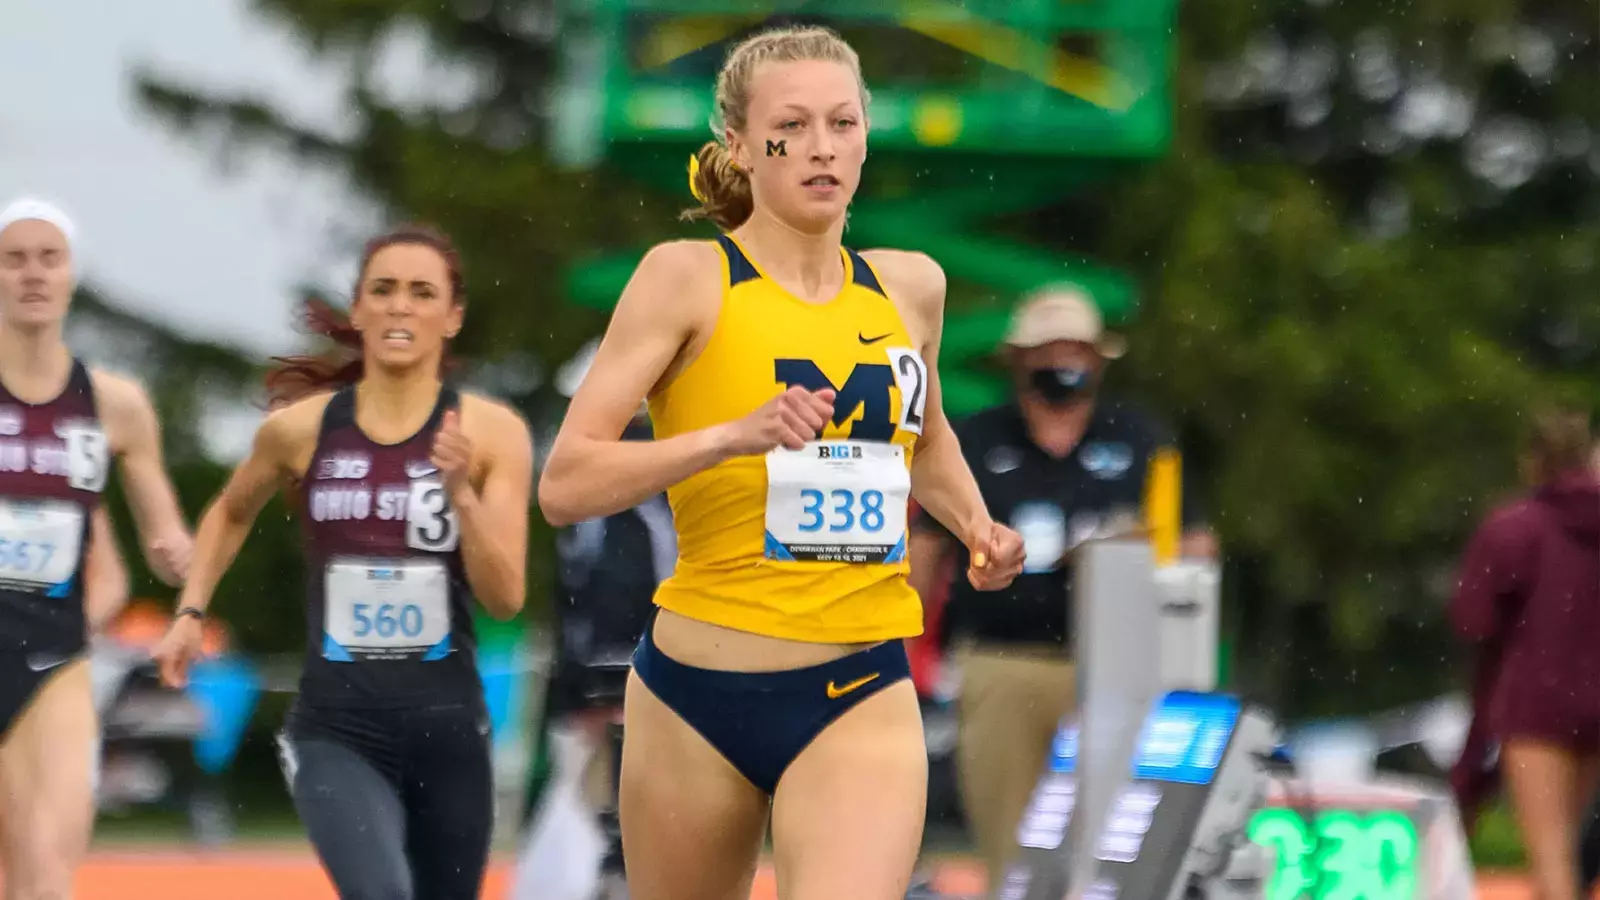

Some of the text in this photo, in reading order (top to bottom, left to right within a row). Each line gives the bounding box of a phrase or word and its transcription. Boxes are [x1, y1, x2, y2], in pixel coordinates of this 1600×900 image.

[765, 139, 787, 157] M
[774, 358, 898, 444] M
[898, 354, 922, 429] 2
[312, 489, 371, 521] OHIO
[418, 487, 451, 547] 3
[798, 488, 885, 533] 338
[353, 604, 424, 638] 560
